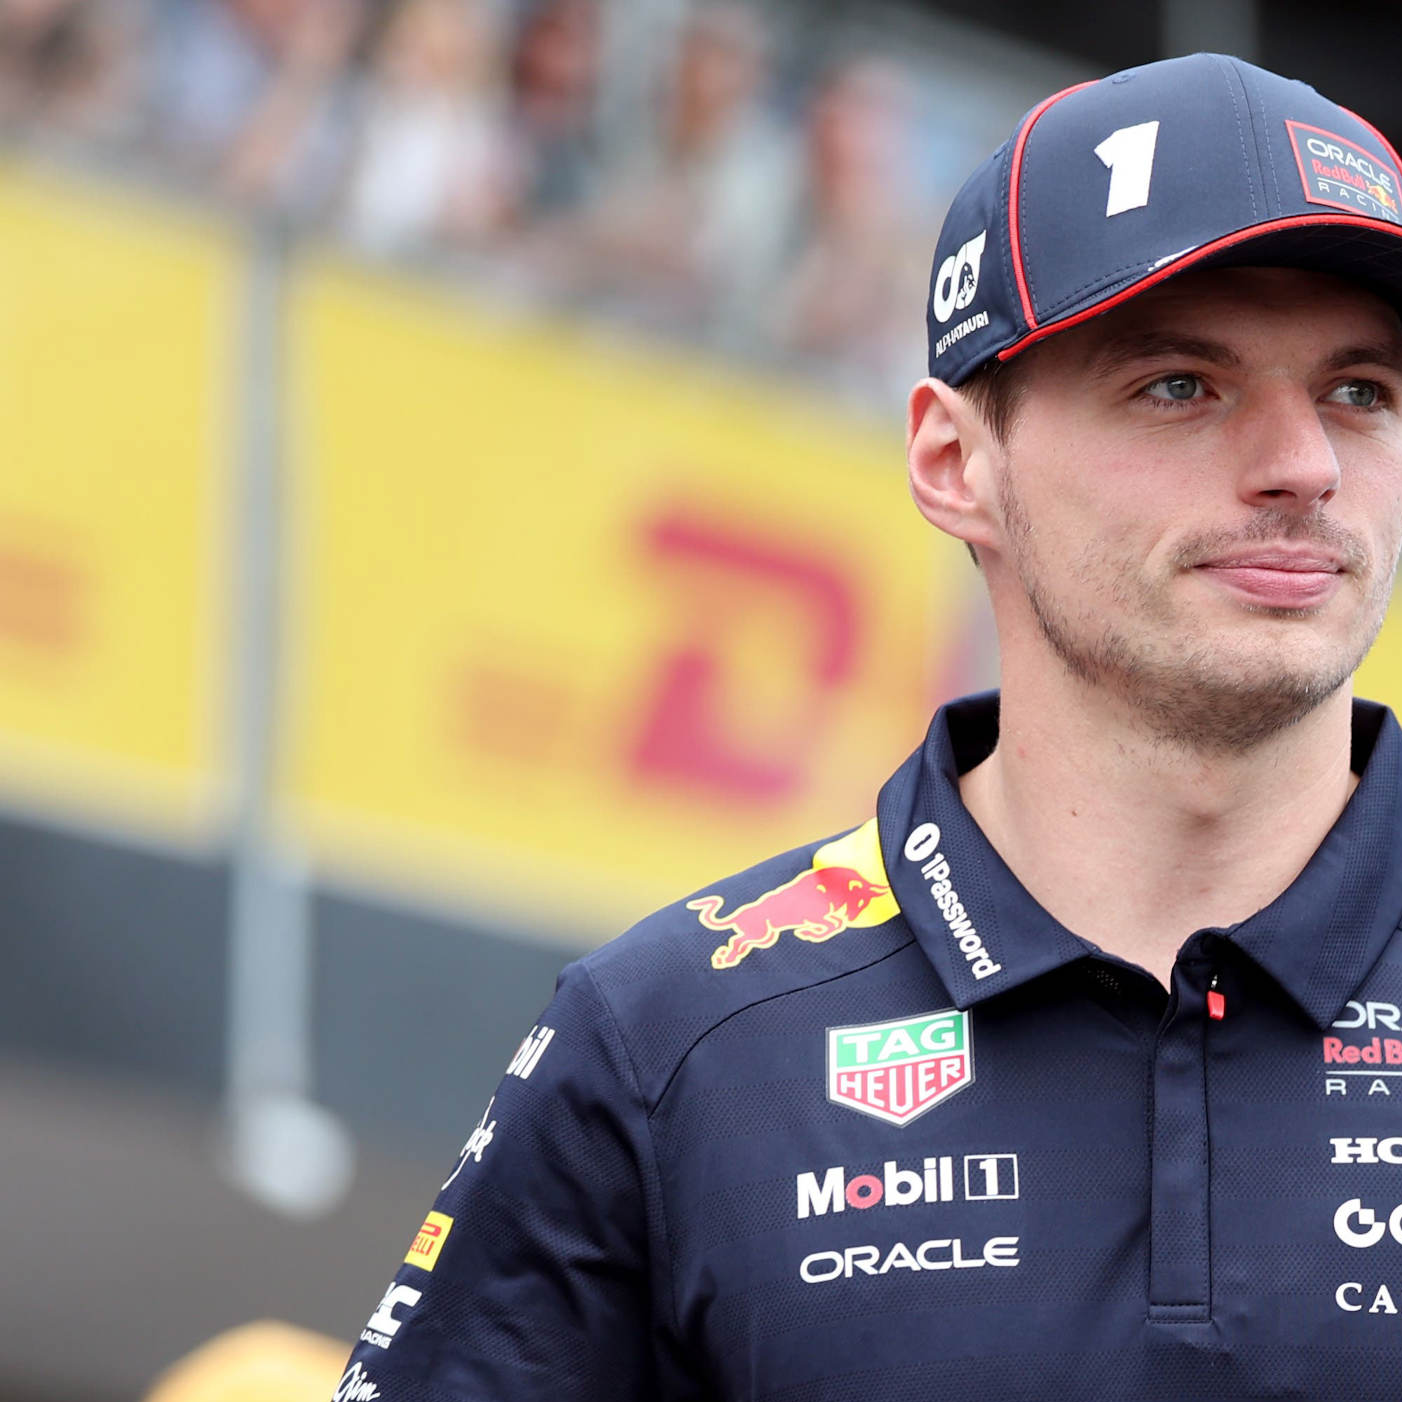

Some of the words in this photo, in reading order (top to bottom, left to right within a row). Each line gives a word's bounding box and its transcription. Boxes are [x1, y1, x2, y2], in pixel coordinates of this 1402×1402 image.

[1094, 120, 1160, 218] 1
[1306, 137, 1393, 194] ORACLE
[1317, 181, 1399, 222] RACIN
[935, 310, 990, 359] ALPHATAURI
[921, 852, 1002, 980] 1Password
[505, 1024, 556, 1080] bil
[841, 1019, 956, 1064] TAG
[1322, 1036, 1383, 1065] Red
[839, 1055, 962, 1113] HEUER
[796, 1156, 953, 1220] Mobil
[978, 1157, 999, 1198] 1
[799, 1236, 1021, 1284] ORACLE
